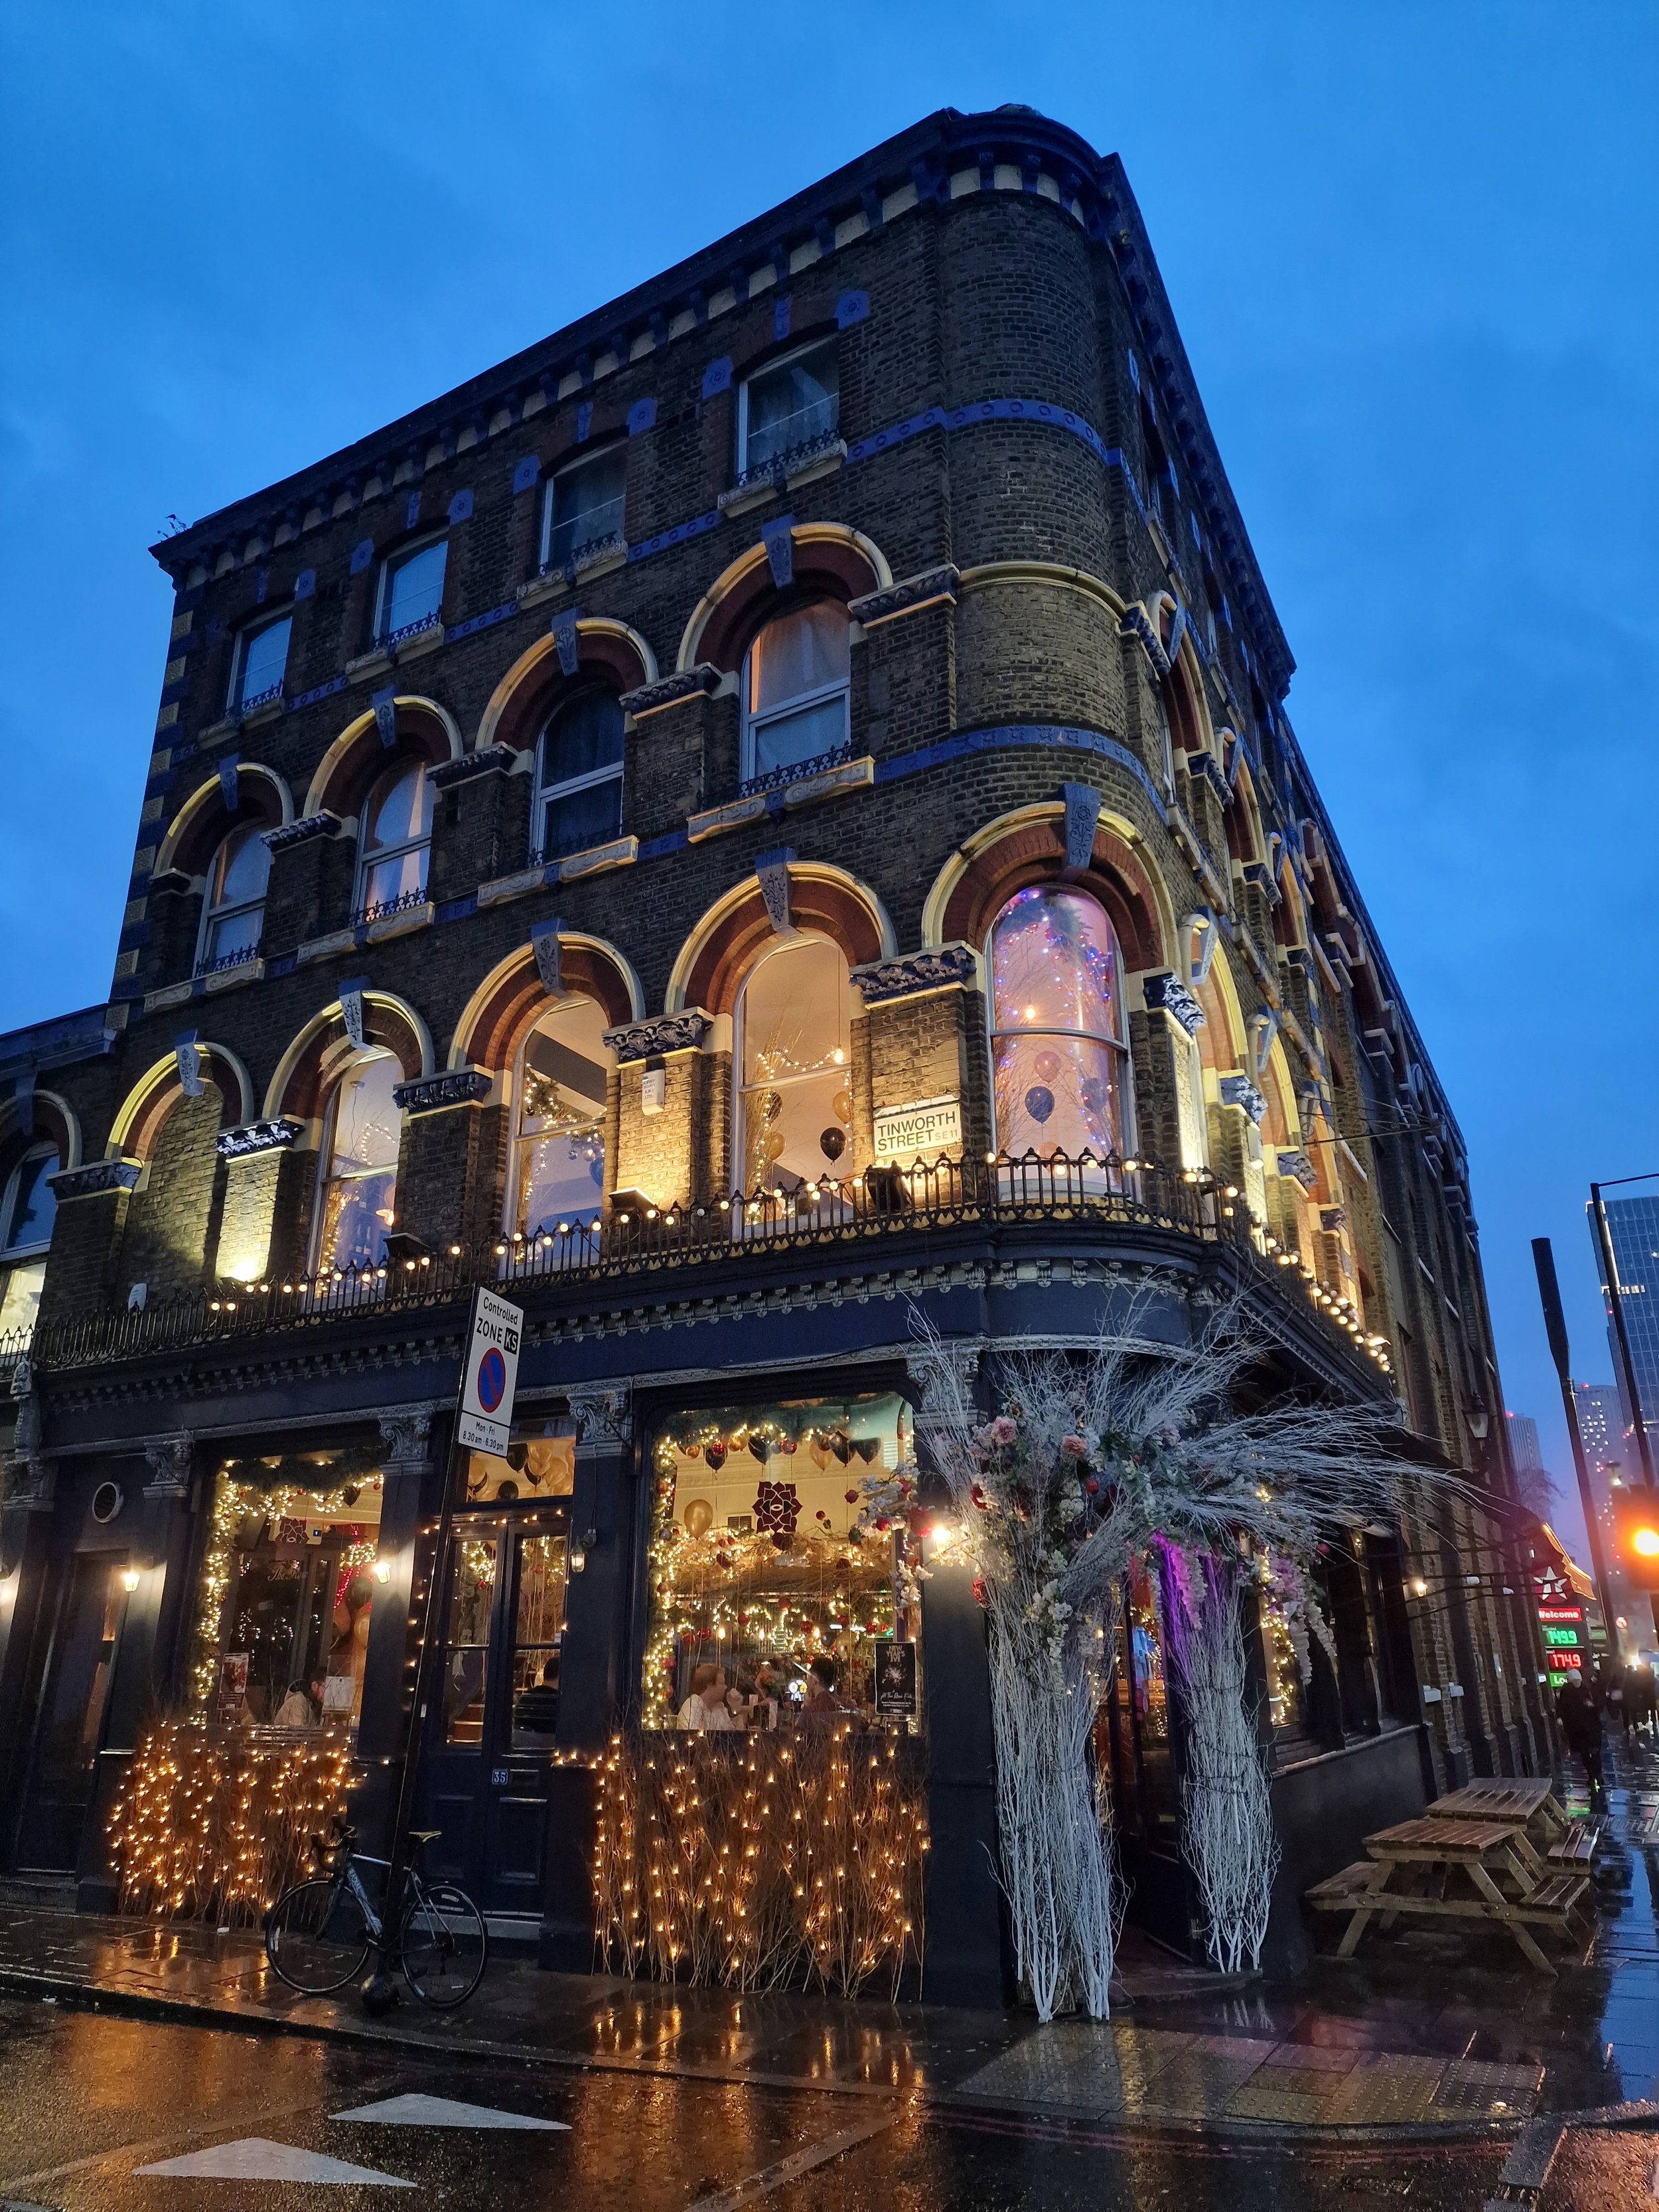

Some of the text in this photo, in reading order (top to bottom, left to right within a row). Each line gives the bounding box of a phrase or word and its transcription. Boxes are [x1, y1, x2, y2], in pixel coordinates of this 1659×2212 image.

[877, 1111, 956, 1138] TINWORTH
[878, 1129, 934, 1151] STREET
[483, 1296, 518, 1325] Controlled
[476, 1317, 518, 1351] ZONE KS
[475, 1421, 486, 1433] Mon
[463, 1430, 475, 1442] 8.30
[485, 1438, 496, 1449] 6.30
[496, 1443, 504, 1451] pm
[1538, 1610, 1579, 1619] Welcome
[494, 1771, 506, 1783] 35
